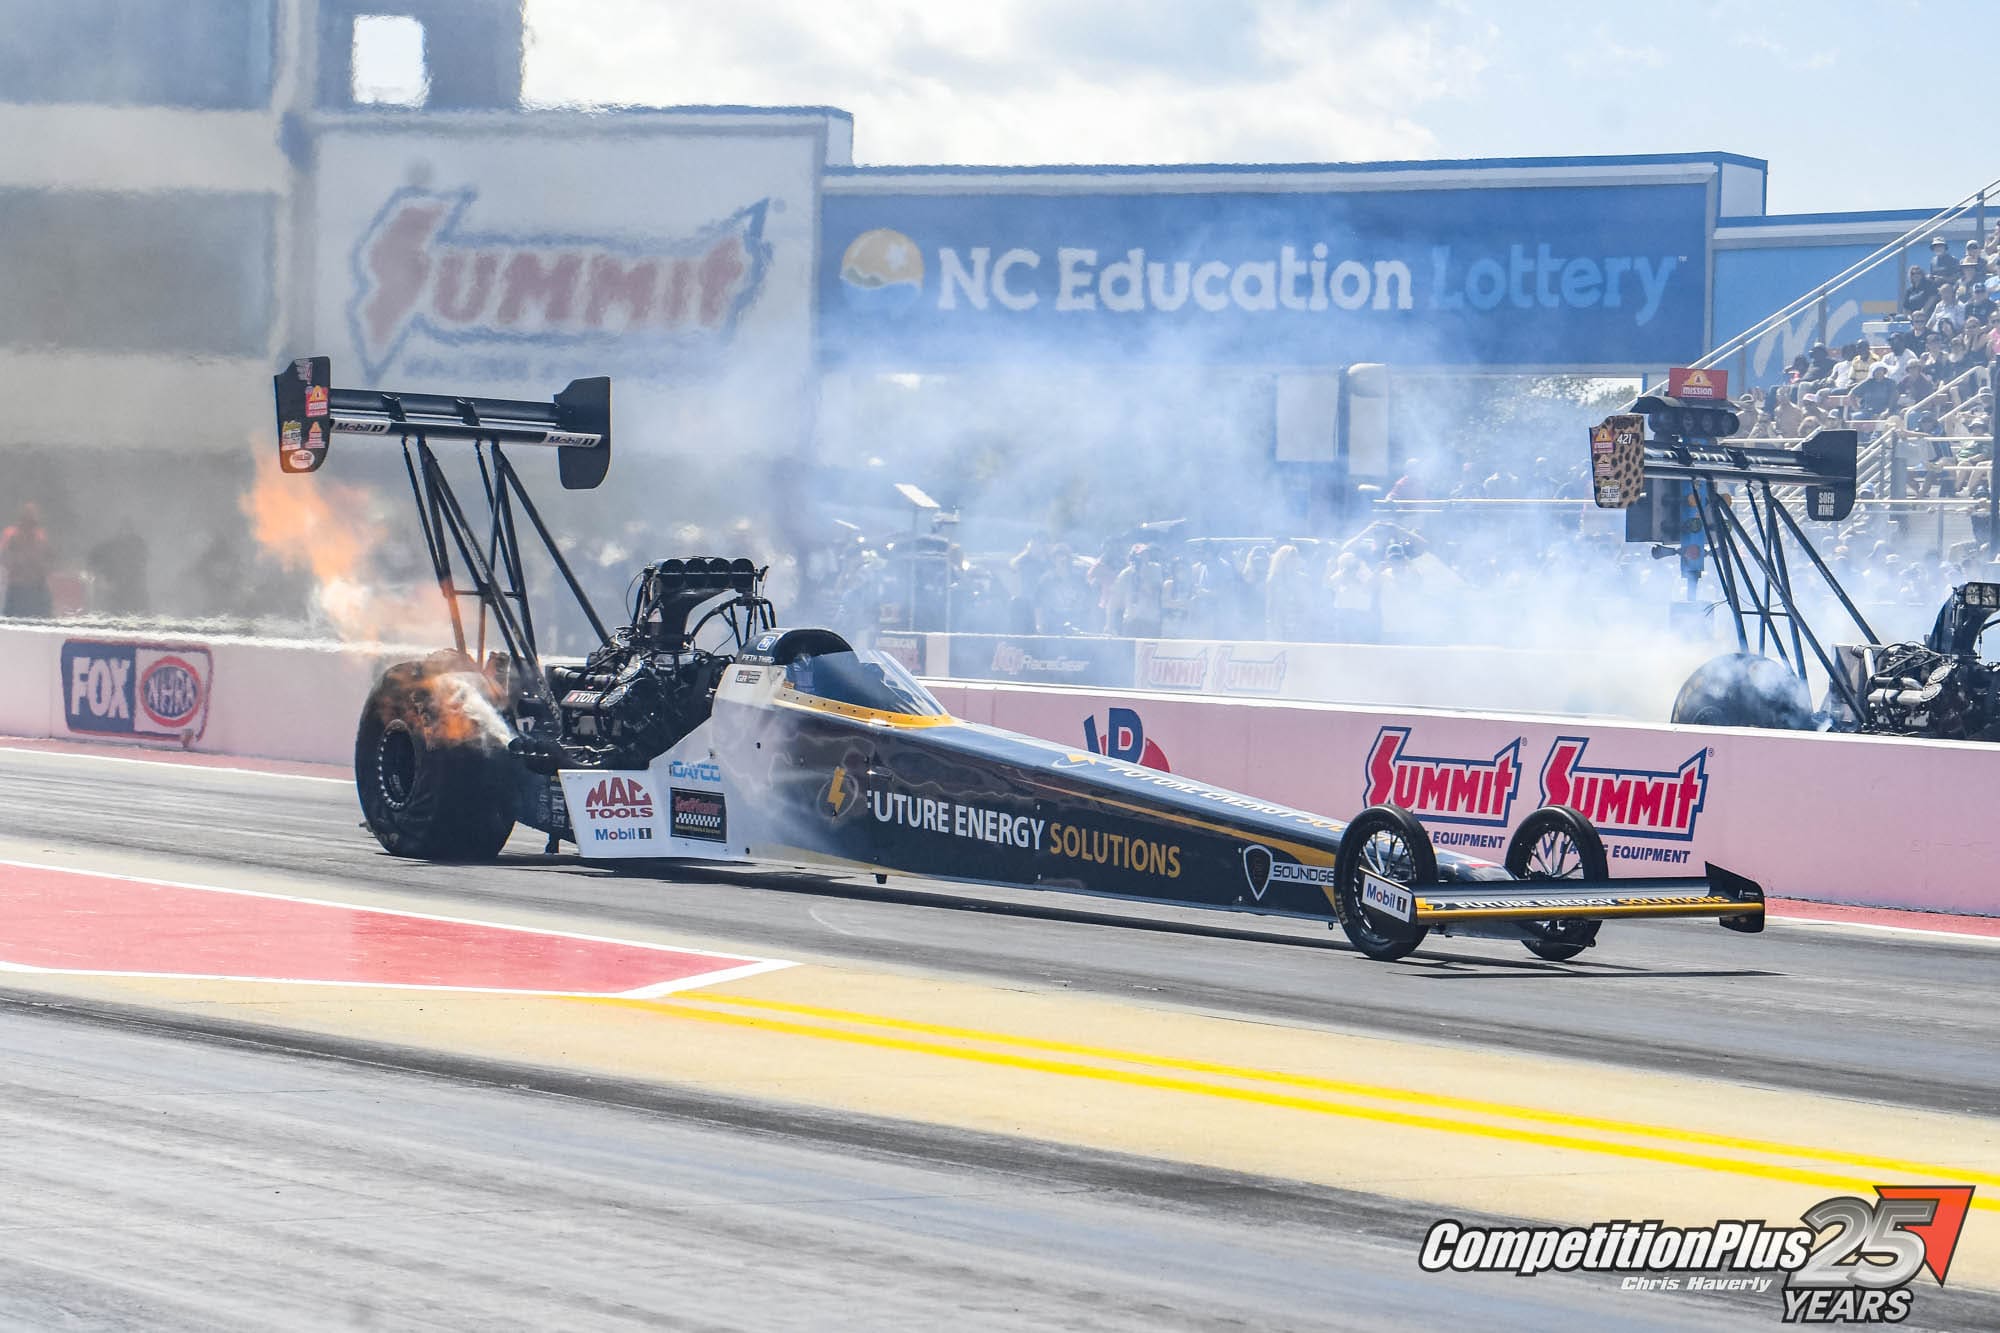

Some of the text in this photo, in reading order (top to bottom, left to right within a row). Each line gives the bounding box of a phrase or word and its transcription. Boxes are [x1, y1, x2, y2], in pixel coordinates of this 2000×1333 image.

[938, 242, 1678, 327] NC Education Lottery
[336, 422, 371, 432] Mobil
[549, 435, 580, 446] Mobil
[1617, 433, 1632, 445] 421
[742, 654, 758, 662] FIFTH
[737, 674, 748, 682] GR
[71, 656, 131, 720] FOX
[147, 668, 197, 716] NHRA
[672, 760, 721, 782] DAYCO
[585, 776, 653, 808] MAC
[585, 807, 654, 819] TOOLS
[595, 827, 652, 841] Mobil 1
[954, 803, 1046, 851] ENERGY
[1049, 822, 1181, 878] SOLUTIONS
[1432, 830, 1506, 849] EQUIPMENT
[1612, 844, 1691, 864] EQUIPMENT
[1366, 882, 1396, 909] Mobil
[1396, 895, 1408, 914] 1
[1455, 895, 1730, 909] FUTURE ENERGY SOLUTIONS
